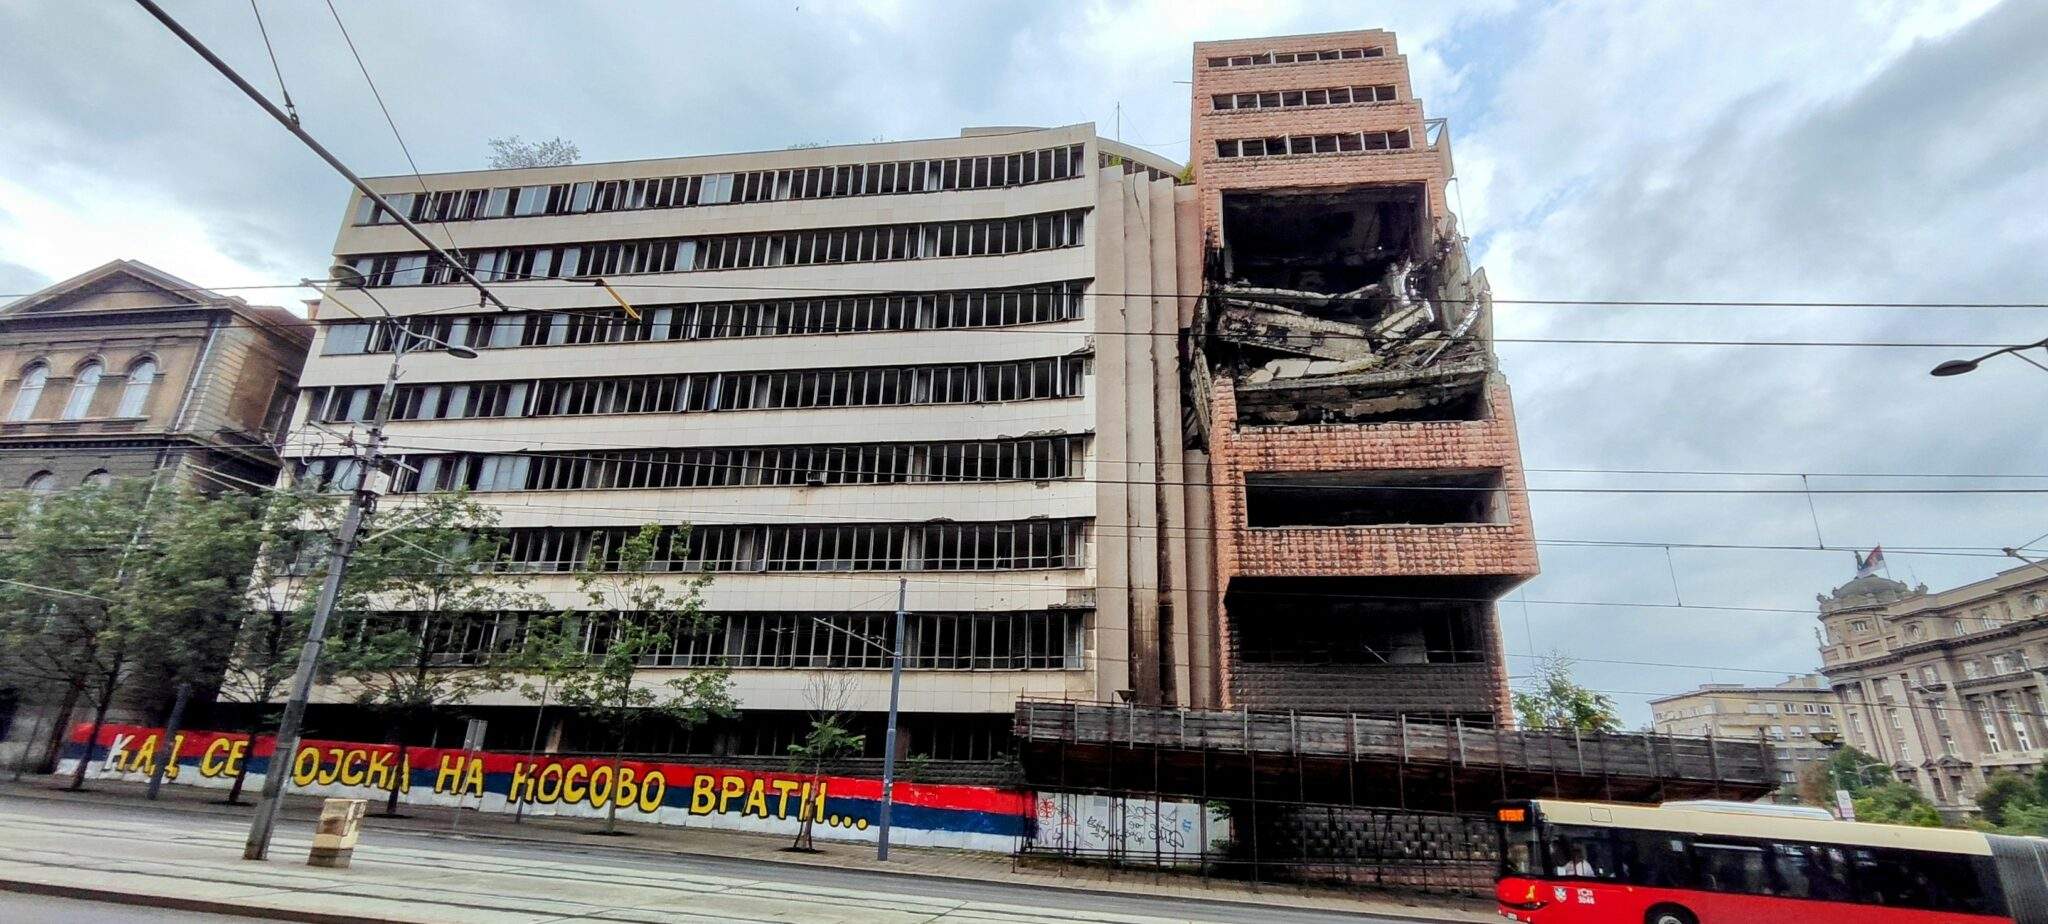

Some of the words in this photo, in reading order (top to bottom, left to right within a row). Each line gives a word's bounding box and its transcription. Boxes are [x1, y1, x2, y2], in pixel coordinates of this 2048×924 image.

[200, 737, 249, 777] СЕ
[293, 746, 410, 793] ОЈСКА
[433, 754, 485, 797] НА
[507, 761, 666, 812] КОСОВО
